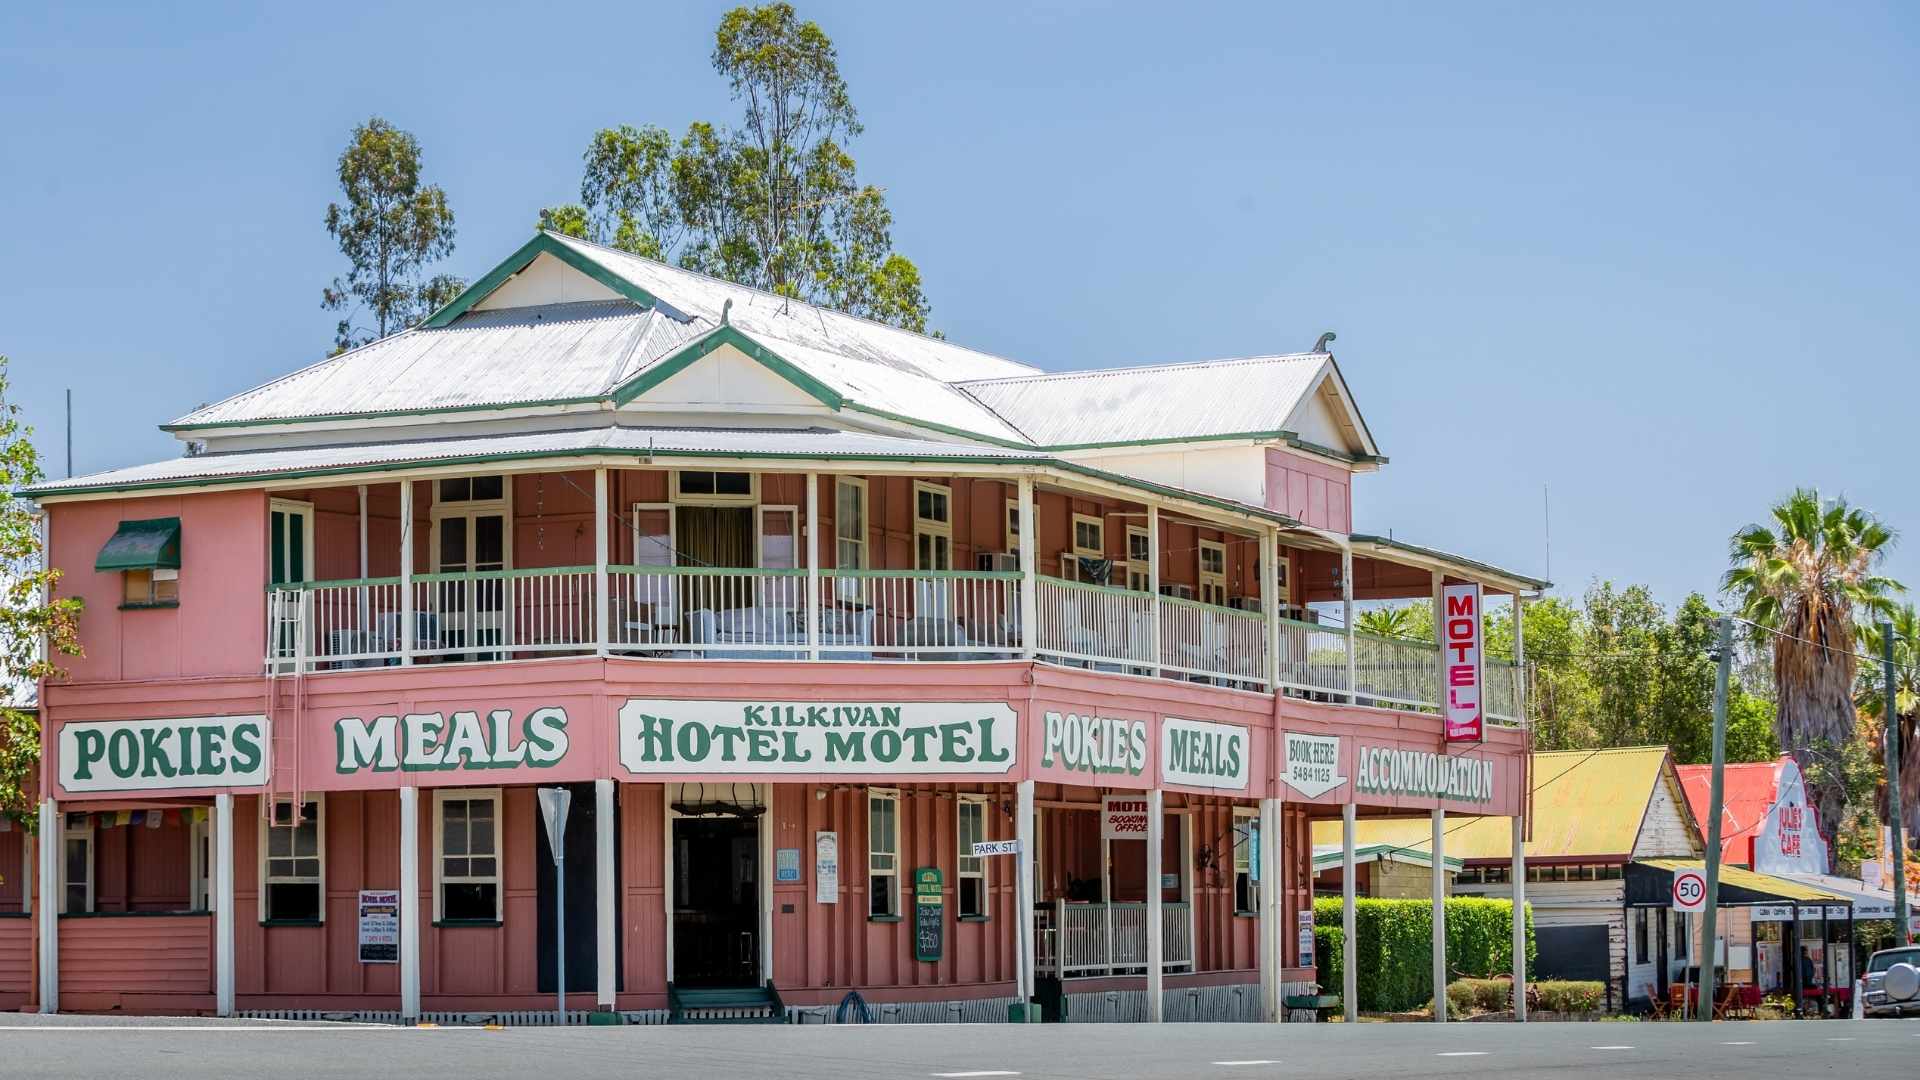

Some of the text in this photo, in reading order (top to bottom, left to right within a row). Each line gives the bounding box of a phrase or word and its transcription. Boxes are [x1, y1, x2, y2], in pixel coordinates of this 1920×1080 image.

[1448, 595, 1475, 709] MOTEL
[744, 705, 901, 728] KILKIVAN
[73, 723, 262, 780] POKIES
[335, 706, 569, 774] MEALS
[638, 714, 1010, 763] HOTEL MOTEL
[1041, 711, 1146, 776] POKIES
[1169, 728, 1241, 778] MEALS
[1289, 739, 1335, 765] BOOK HERE
[1293, 766, 1330, 783] 5484 1125
[1355, 745, 1493, 803] ACCOMMODATION
[1107, 801, 1148, 812] MOTE
[1108, 815, 1148, 823] BOOKIN
[974, 842, 1013, 854] PARK ST
[1680, 883, 1700, 897] 50
